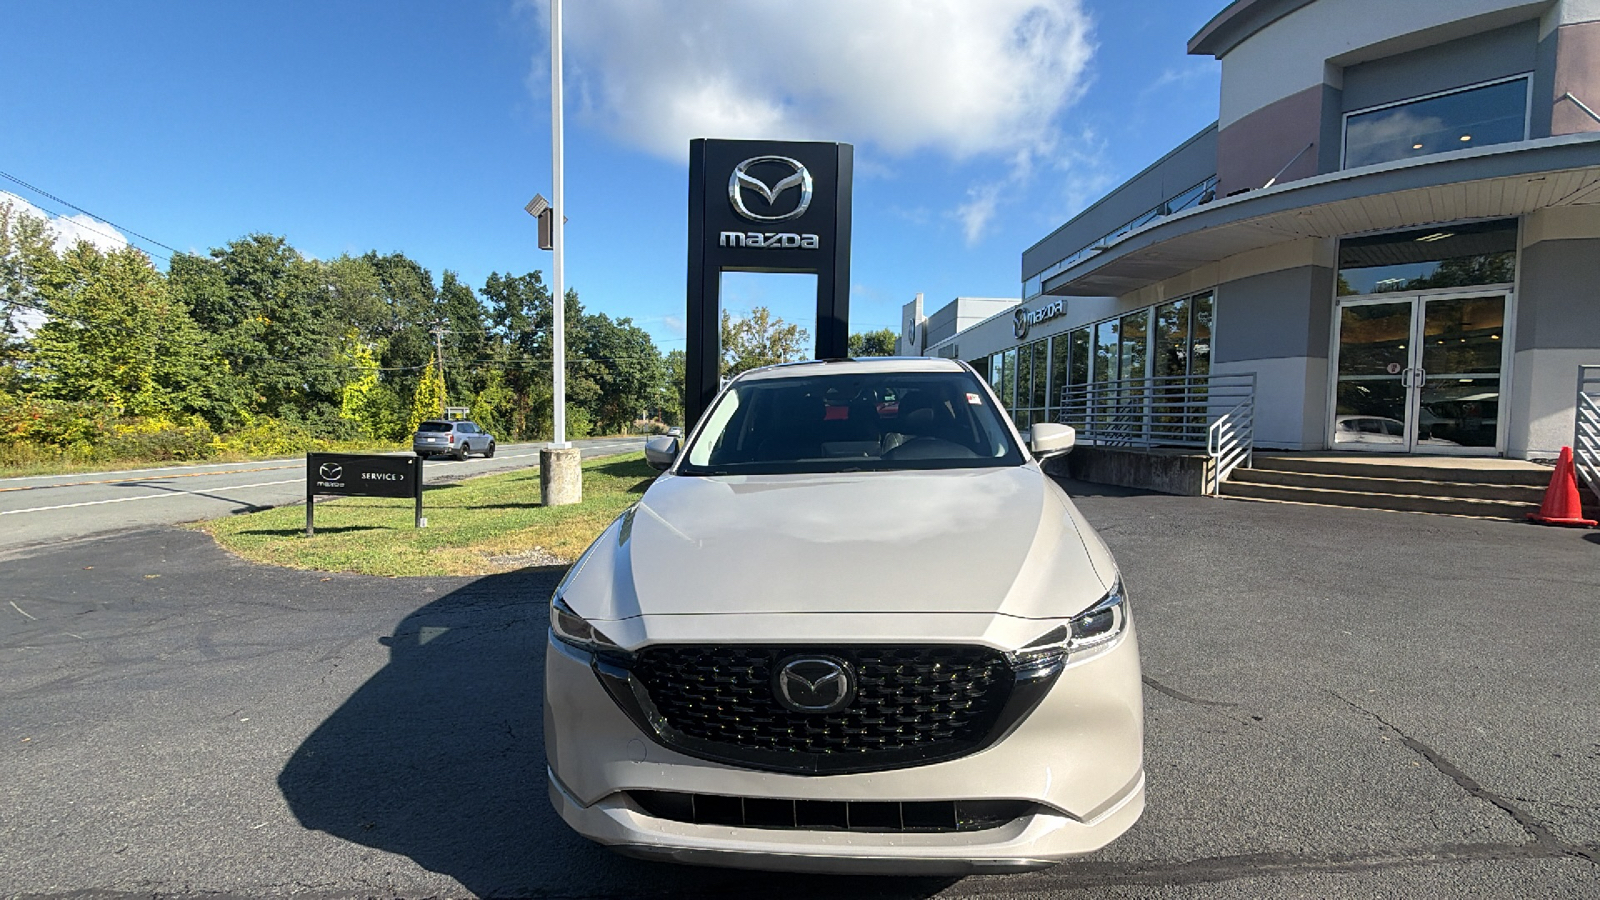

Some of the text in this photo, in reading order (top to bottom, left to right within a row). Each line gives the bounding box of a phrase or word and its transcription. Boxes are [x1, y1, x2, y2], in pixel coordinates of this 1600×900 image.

[719, 231, 819, 250] mazda
[1027, 299, 1064, 325] mazda
[361, 472, 397, 481] SERVICE
